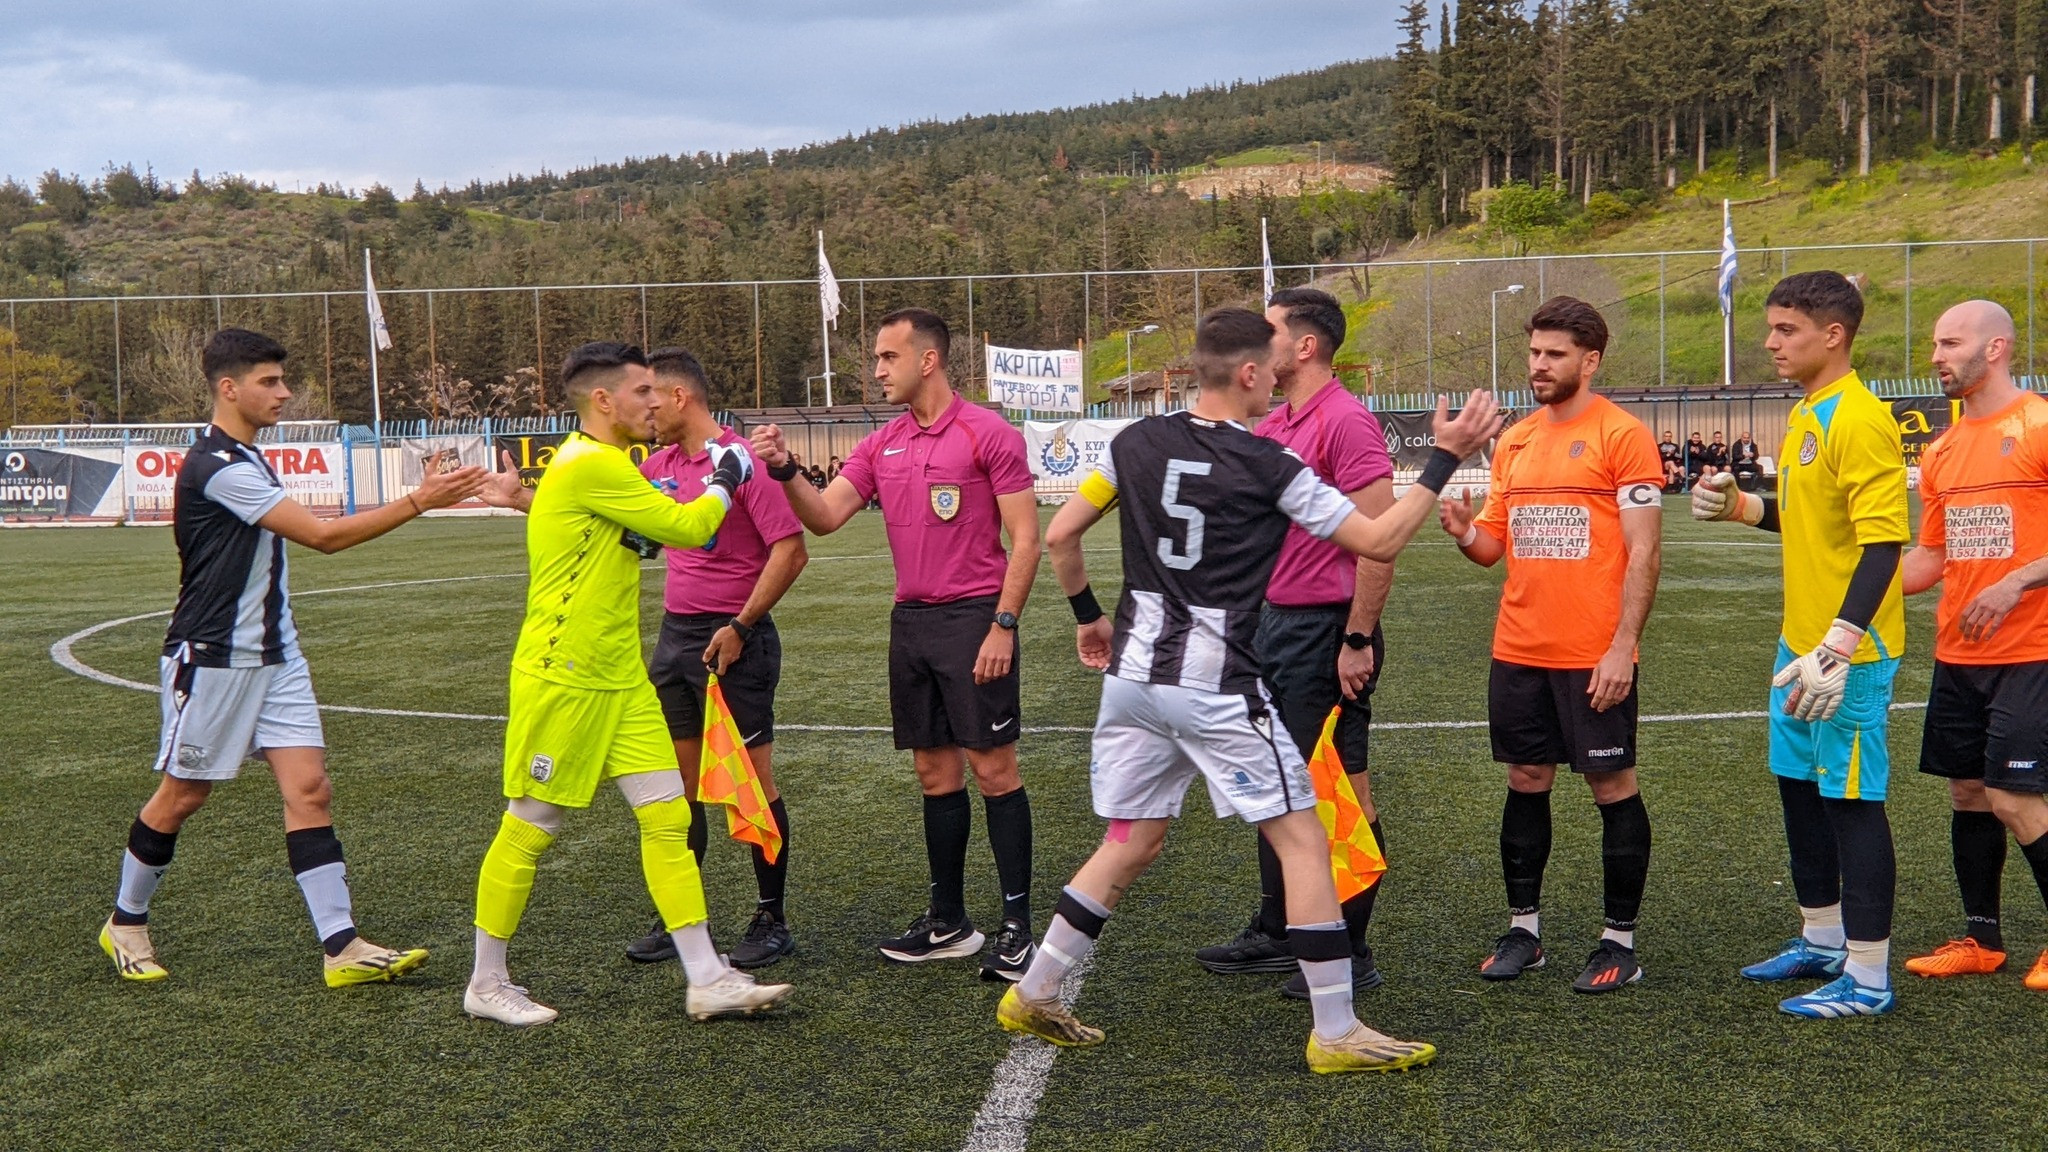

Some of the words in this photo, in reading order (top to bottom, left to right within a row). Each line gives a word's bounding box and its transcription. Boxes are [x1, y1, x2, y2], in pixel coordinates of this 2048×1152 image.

[994, 352, 1061, 378] ΑΚΡΙΤΑΙ
[1045, 384, 1058, 393] ΜΕ
[1002, 388, 1070, 407] ΙΣΤΟΡΙΑ
[137, 484, 167, 492] ΜΟΔΑ
[1782, 465, 1789, 511] 1
[1628, 485, 1653, 505] C
[1157, 459, 1212, 570] 5
[1516, 506, 1581, 517] ΣΥΝΕΡΓΕΙΟ
[1511, 517, 1588, 527] ΑΥΤΟΚΙΝΗΤΩΝ
[1538, 527, 1587, 537] SERVICE
[1960, 527, 2011, 537] SERVICE
[1535, 547, 1553, 557] 582
[1558, 548, 1581, 558] 187
[1956, 548, 1976, 558] 582
[1981, 547, 2005, 557] 187
[1588, 747, 1624, 757] macron
